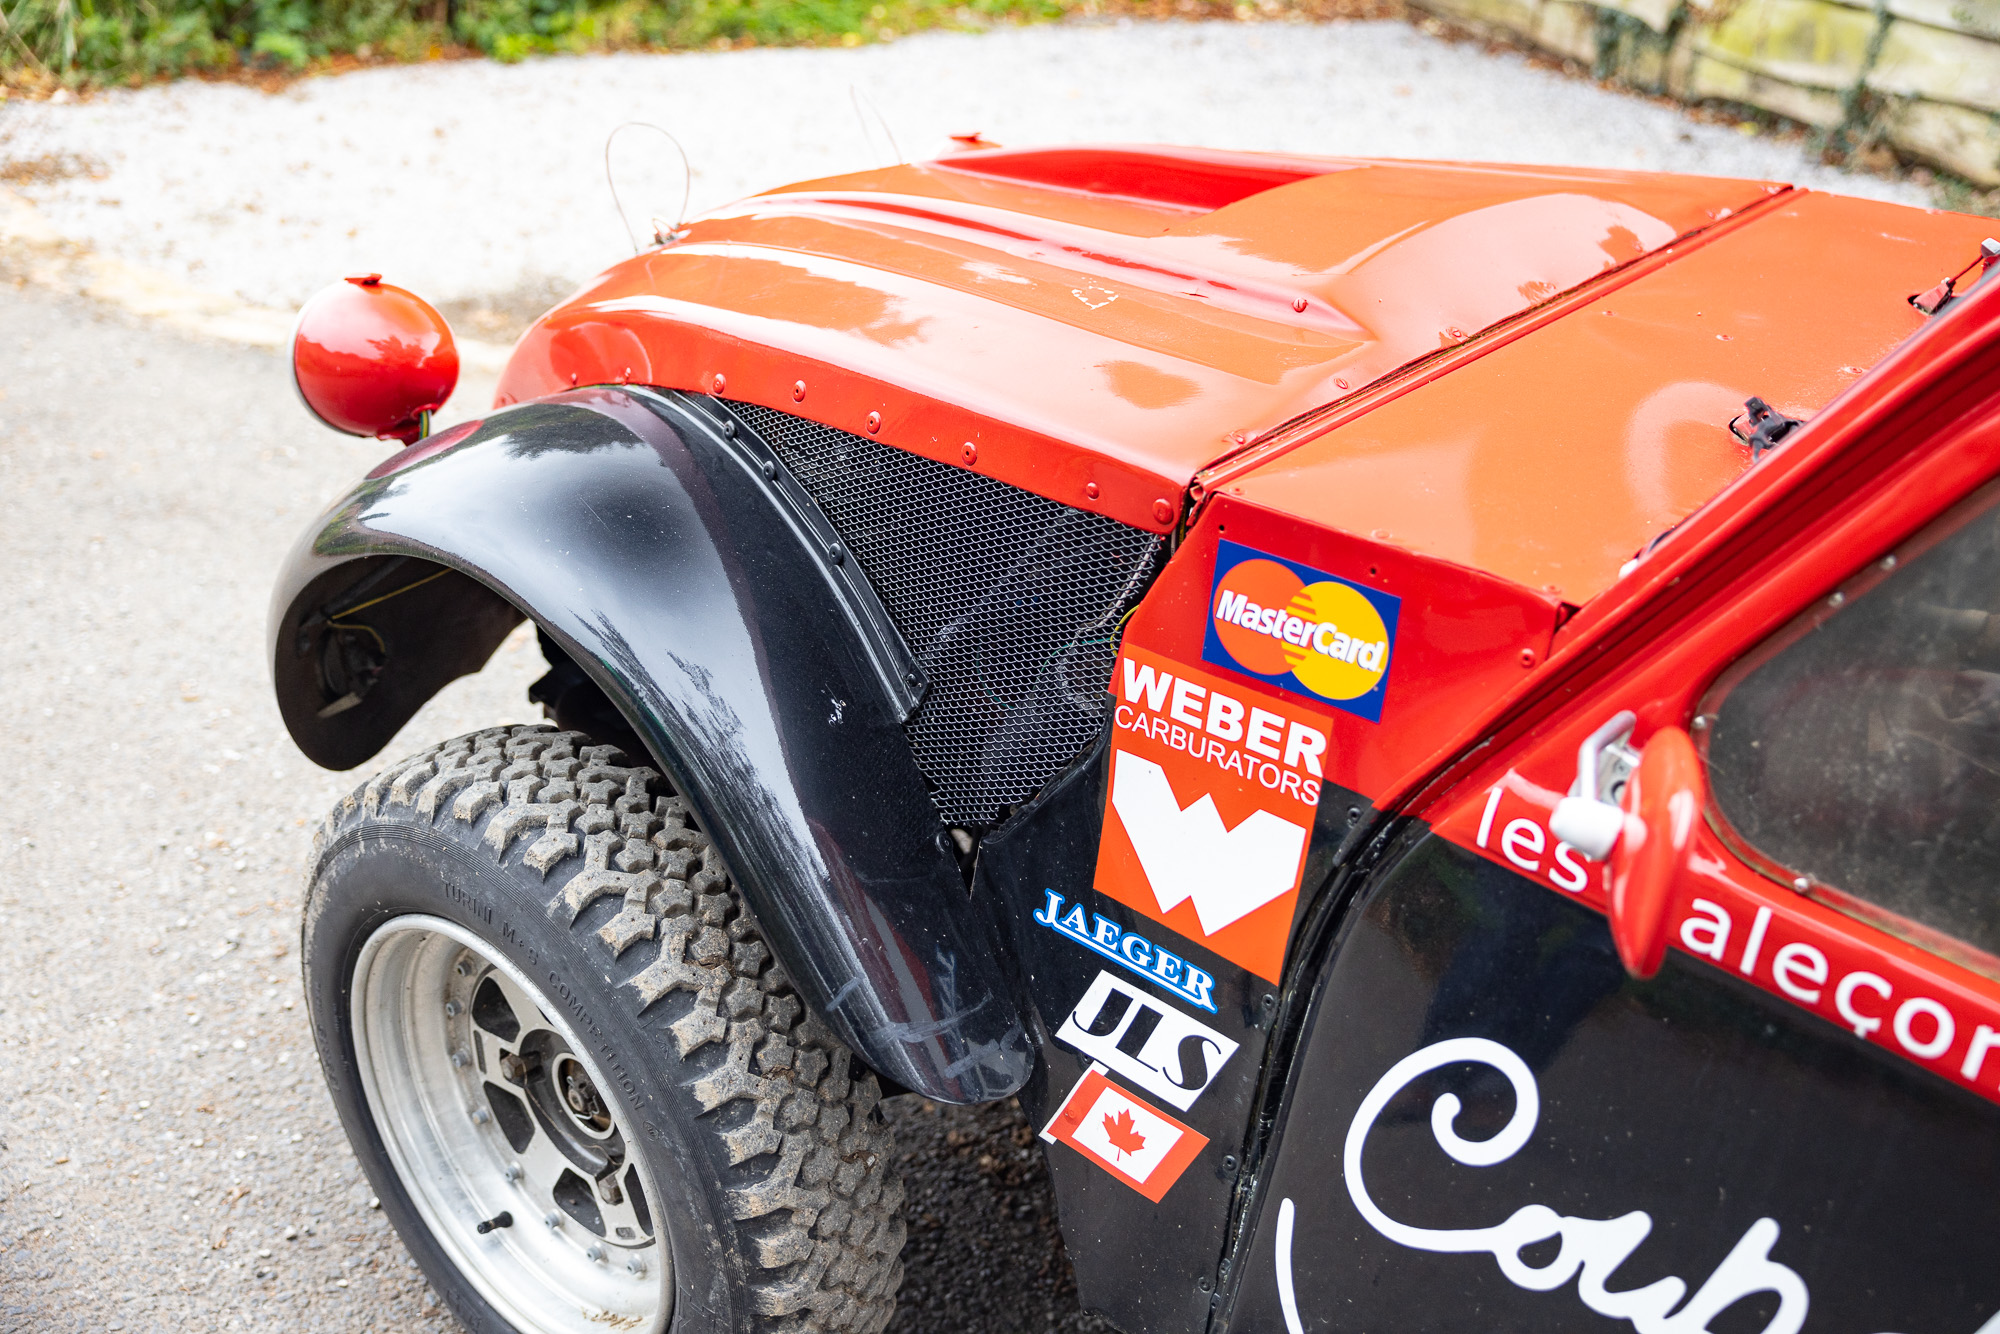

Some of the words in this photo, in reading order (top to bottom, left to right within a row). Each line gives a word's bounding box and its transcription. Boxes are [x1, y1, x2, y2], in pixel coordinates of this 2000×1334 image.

[1215, 588, 1385, 673] MasterCard
[1114, 705, 1320, 806] CARBURATORS
[1122, 657, 1327, 778] WEBER
[1476, 787, 1591, 893] les
[1034, 888, 1218, 1013] JAEGER
